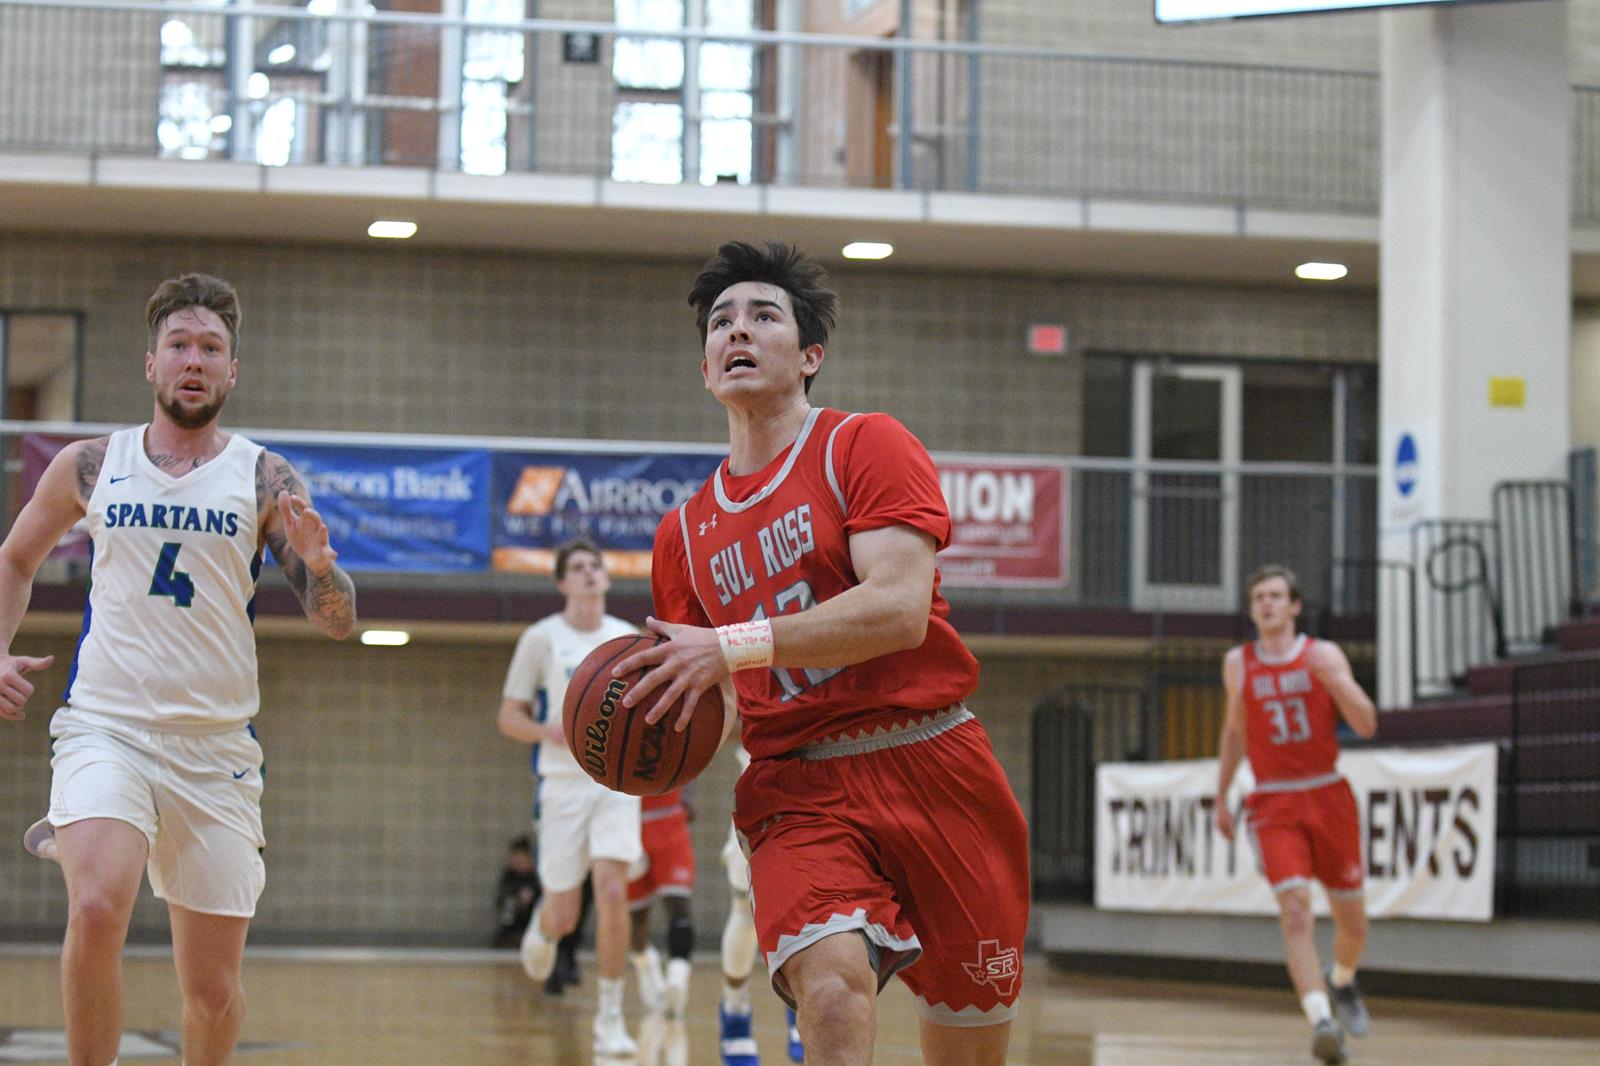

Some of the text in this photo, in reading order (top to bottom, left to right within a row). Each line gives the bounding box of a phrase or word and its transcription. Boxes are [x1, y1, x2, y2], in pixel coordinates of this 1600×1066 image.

[393, 465, 474, 500] Bank
[105, 503, 239, 537] SPARTANS
[148, 541, 195, 608] 4
[709, 503, 815, 606] SUL ROSS
[584, 679, 629, 777] Wilson
[1264, 698, 1312, 744] 33
[1367, 788, 1480, 879] ENTS
[986, 958, 1014, 975] SR
